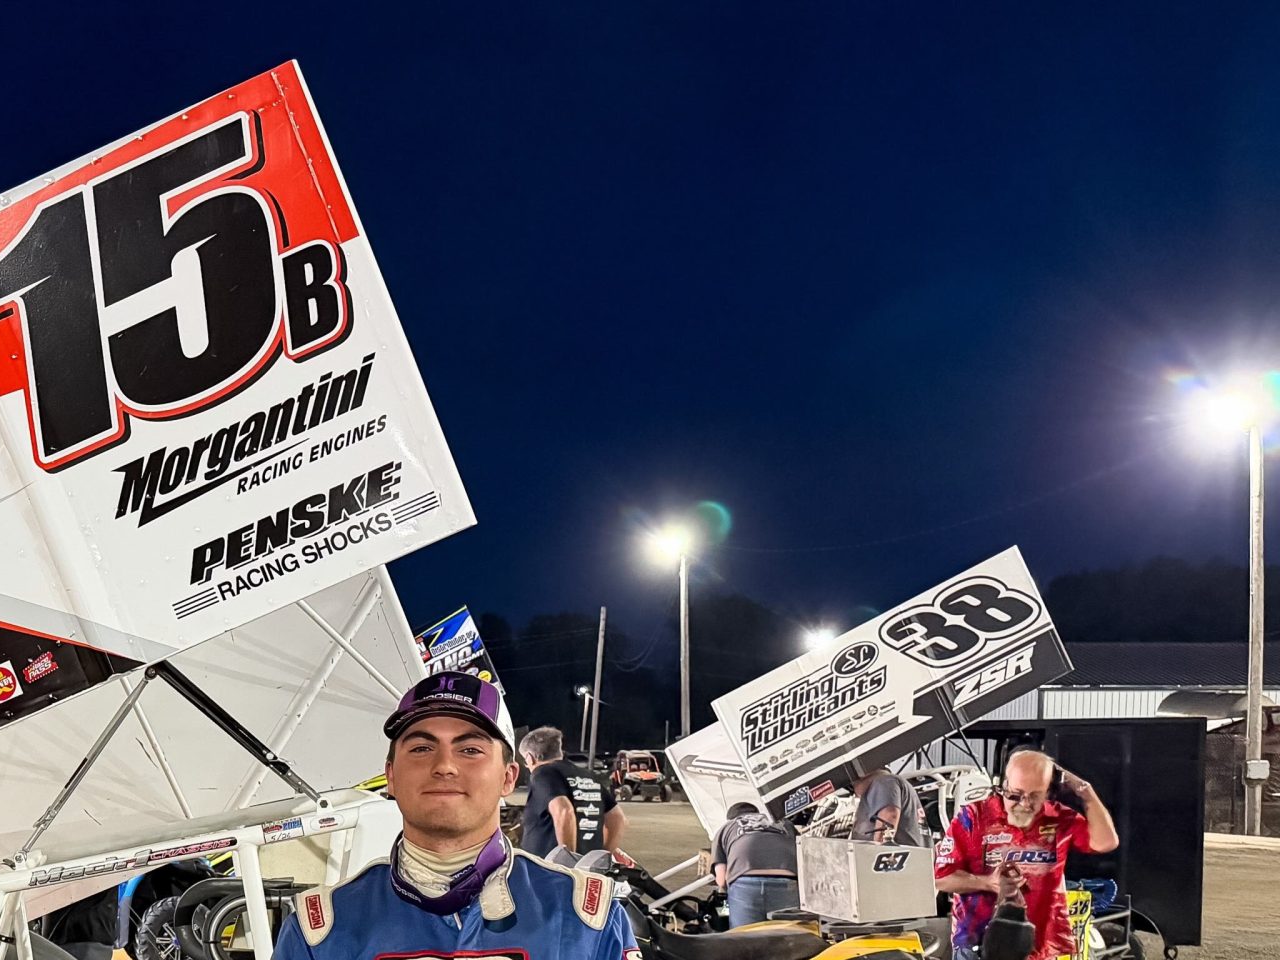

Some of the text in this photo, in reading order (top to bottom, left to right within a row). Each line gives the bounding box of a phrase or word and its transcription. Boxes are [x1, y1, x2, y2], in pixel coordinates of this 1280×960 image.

[111, 354, 375, 528] Morgantini
[236, 414, 388, 496] RACING ENGINES
[190, 461, 403, 585] PENSKE
[216, 512, 393, 601] RACING SHOCKS
[881, 577, 1040, 666] 38
[742, 675, 835, 732] Stirling
[747, 667, 886, 756] Lubricants
[953, 642, 1036, 711] ZSR
[586, 879, 600, 912] SIMPSON
